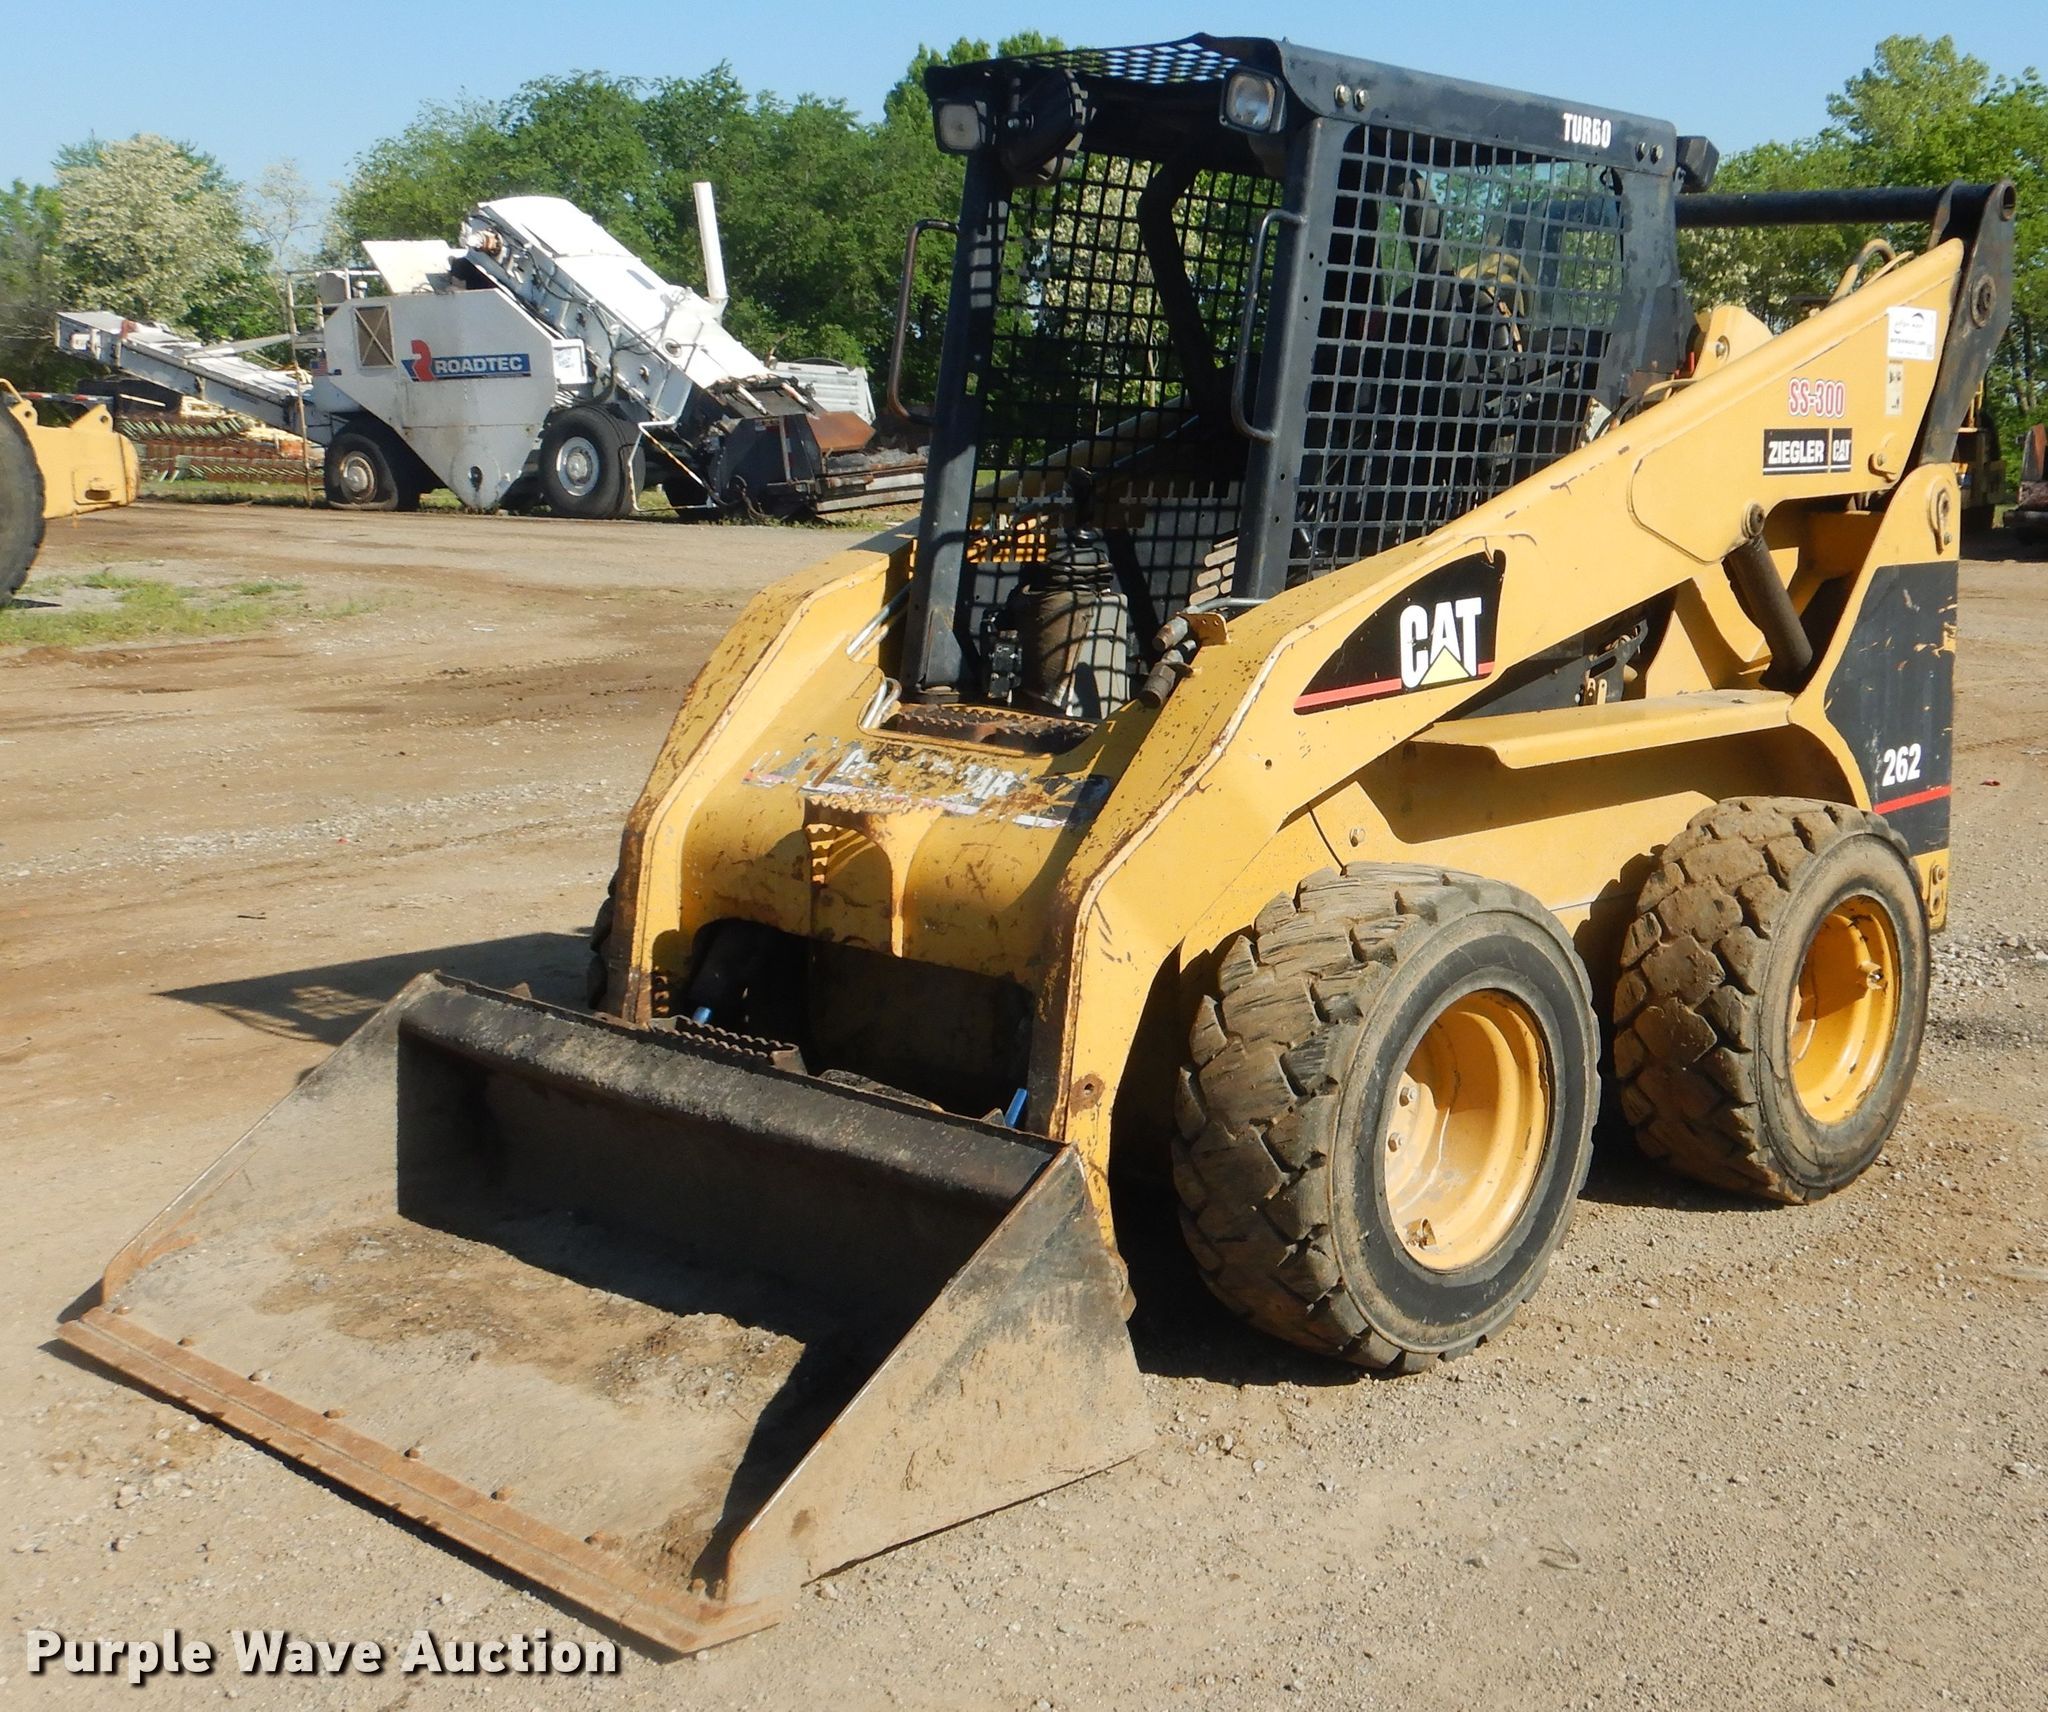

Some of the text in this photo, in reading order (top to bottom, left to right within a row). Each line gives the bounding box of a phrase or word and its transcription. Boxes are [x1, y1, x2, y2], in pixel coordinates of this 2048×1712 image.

[1563, 112, 1612, 149] TURBO
[433, 355, 524, 375] ROADTEC
[1788, 377, 1846, 418] SS-300
[1767, 439, 1852, 465] ZIEGLER CAT
[1400, 596, 1483, 689] CAT
[1882, 742, 1922, 787] 262
